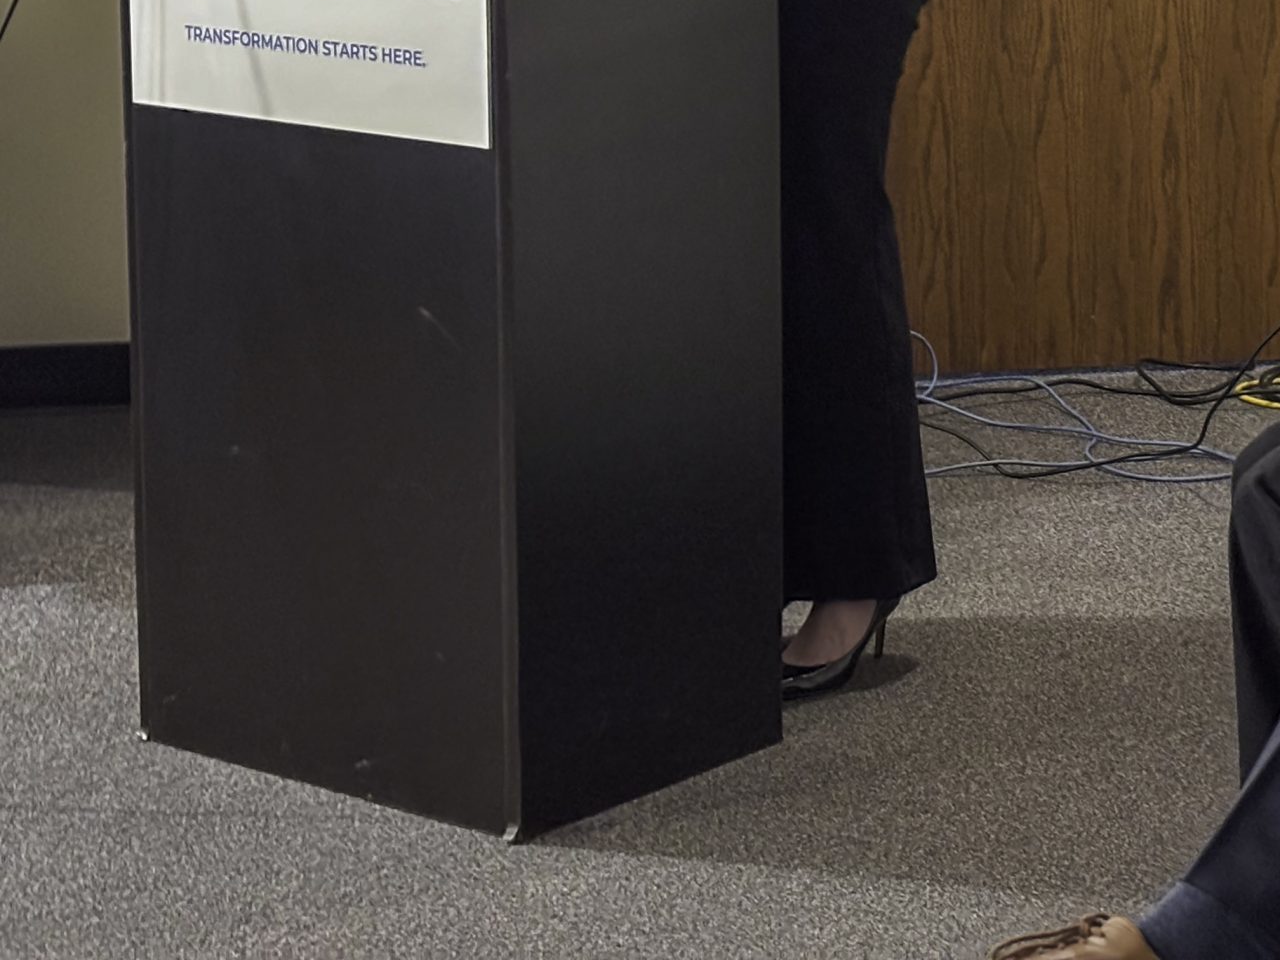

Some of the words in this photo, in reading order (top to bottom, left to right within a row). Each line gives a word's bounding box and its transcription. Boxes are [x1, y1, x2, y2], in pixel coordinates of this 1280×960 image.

[185, 24, 318, 55] TRANSFORMATION
[322, 40, 378, 62] STARTS
[382, 48, 427, 68] HERE.
